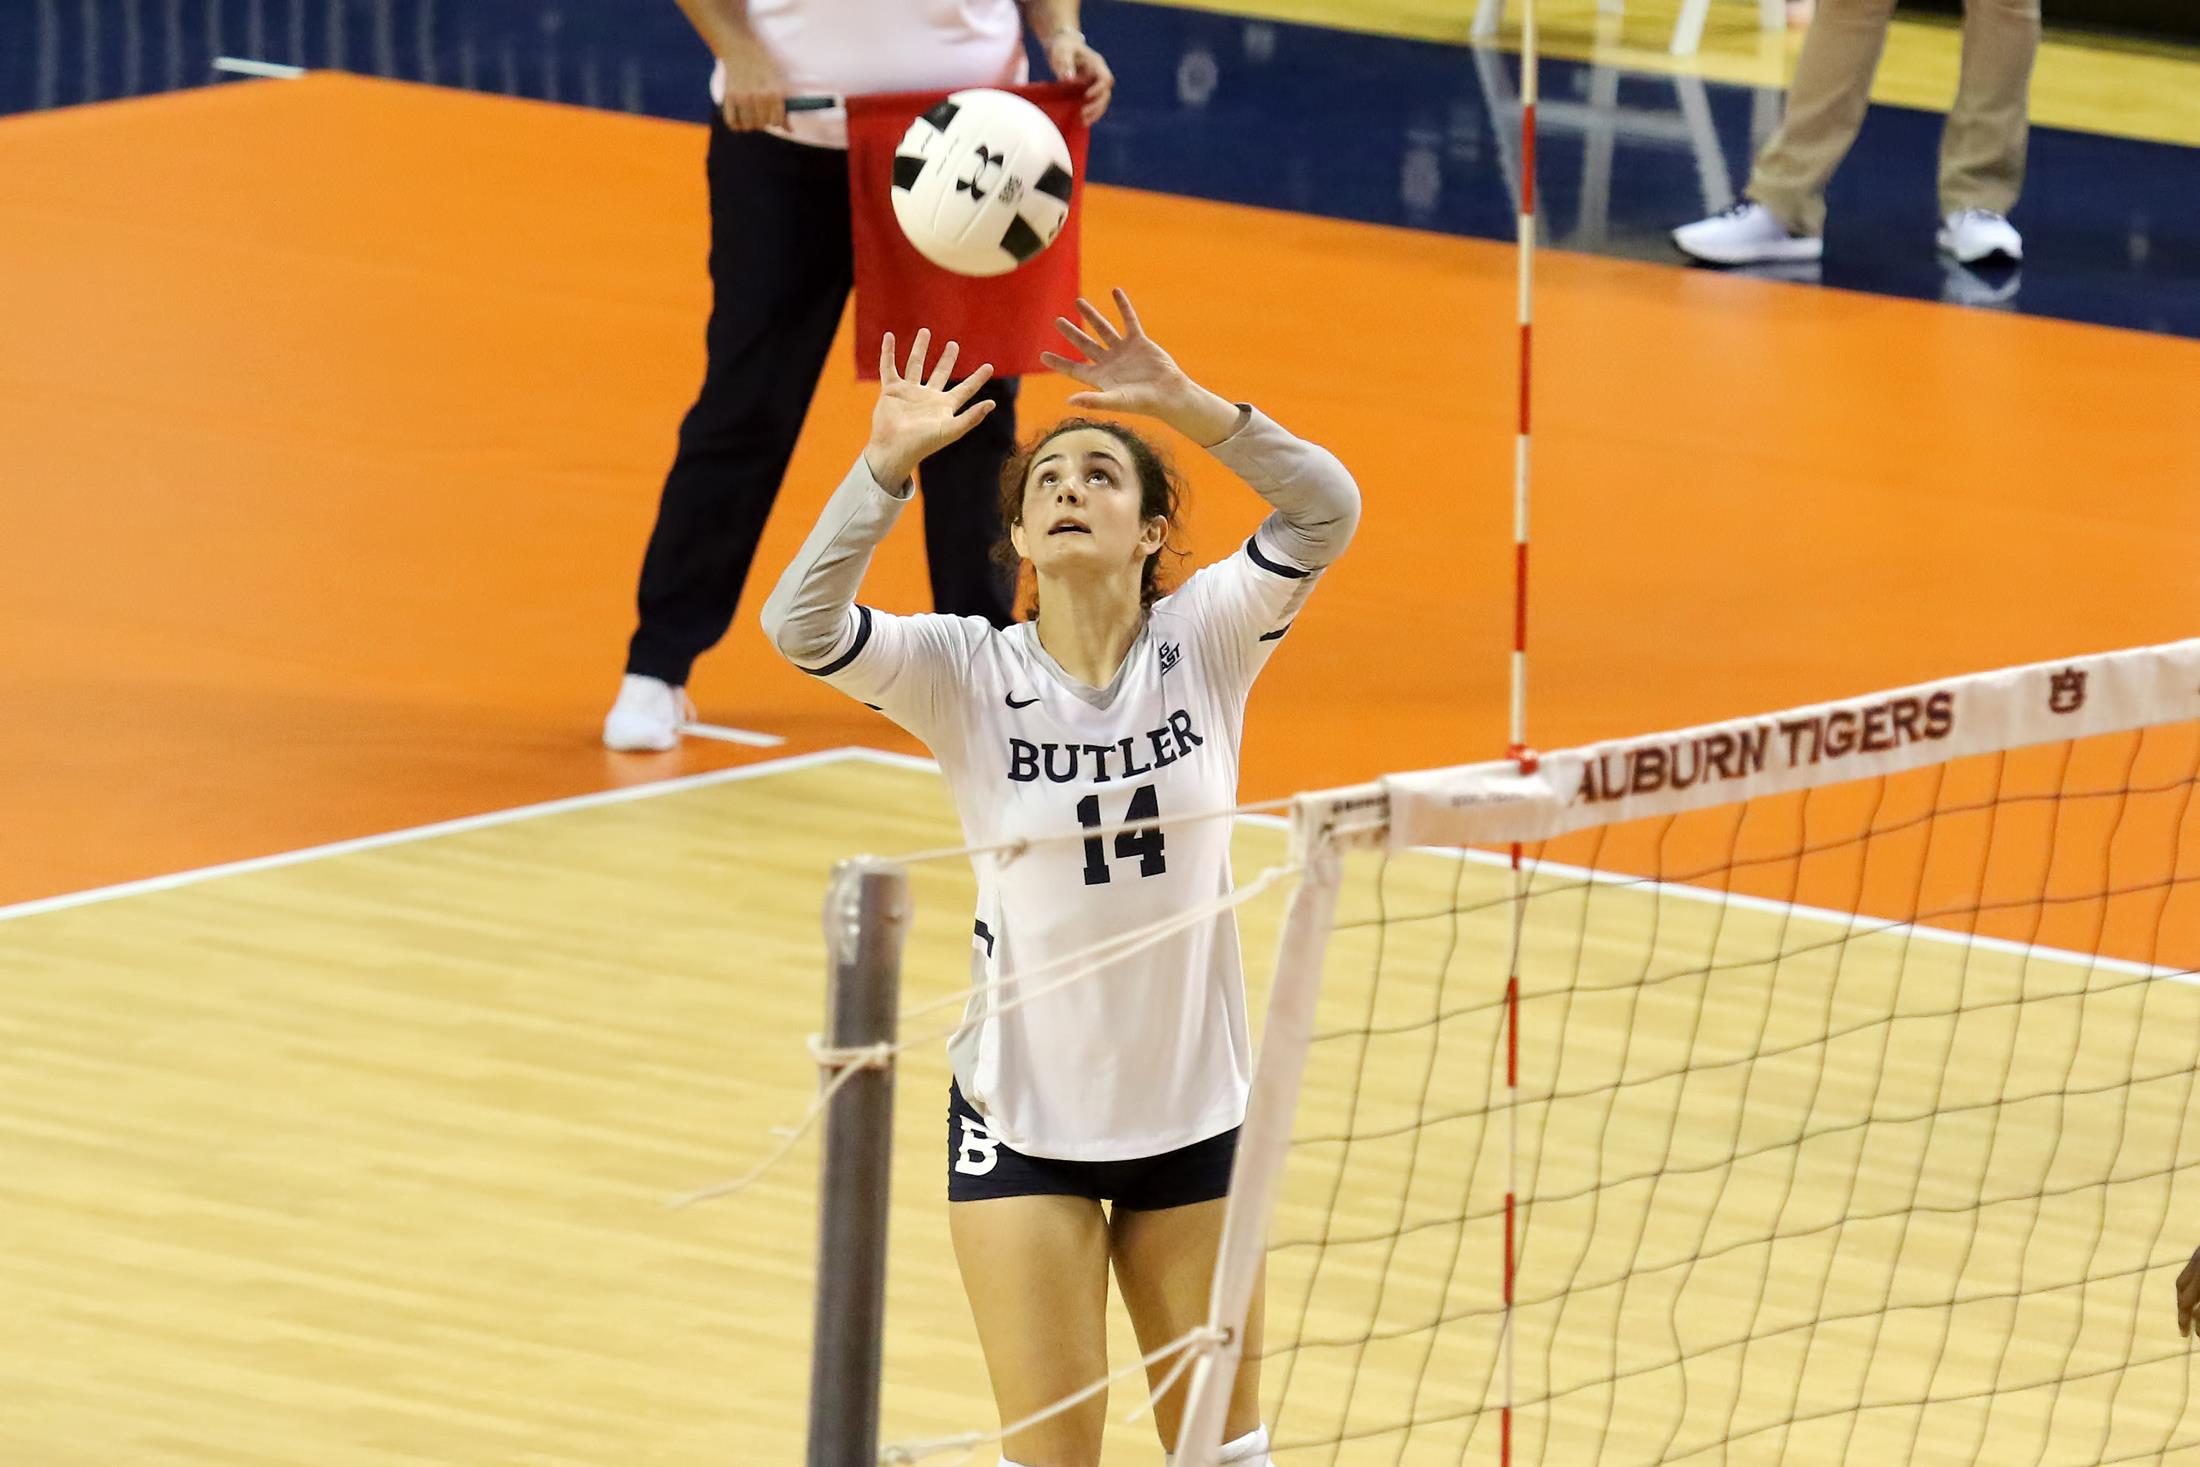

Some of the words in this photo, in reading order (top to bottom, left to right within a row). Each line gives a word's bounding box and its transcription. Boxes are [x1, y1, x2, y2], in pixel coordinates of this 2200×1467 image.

[1007, 708, 1204, 784] BUTLER
[1569, 725, 1771, 808] AUBURN
[1778, 691, 1954, 769] TIGERS
[1076, 783, 1167, 886] 14
[954, 1114, 1001, 1177] B
